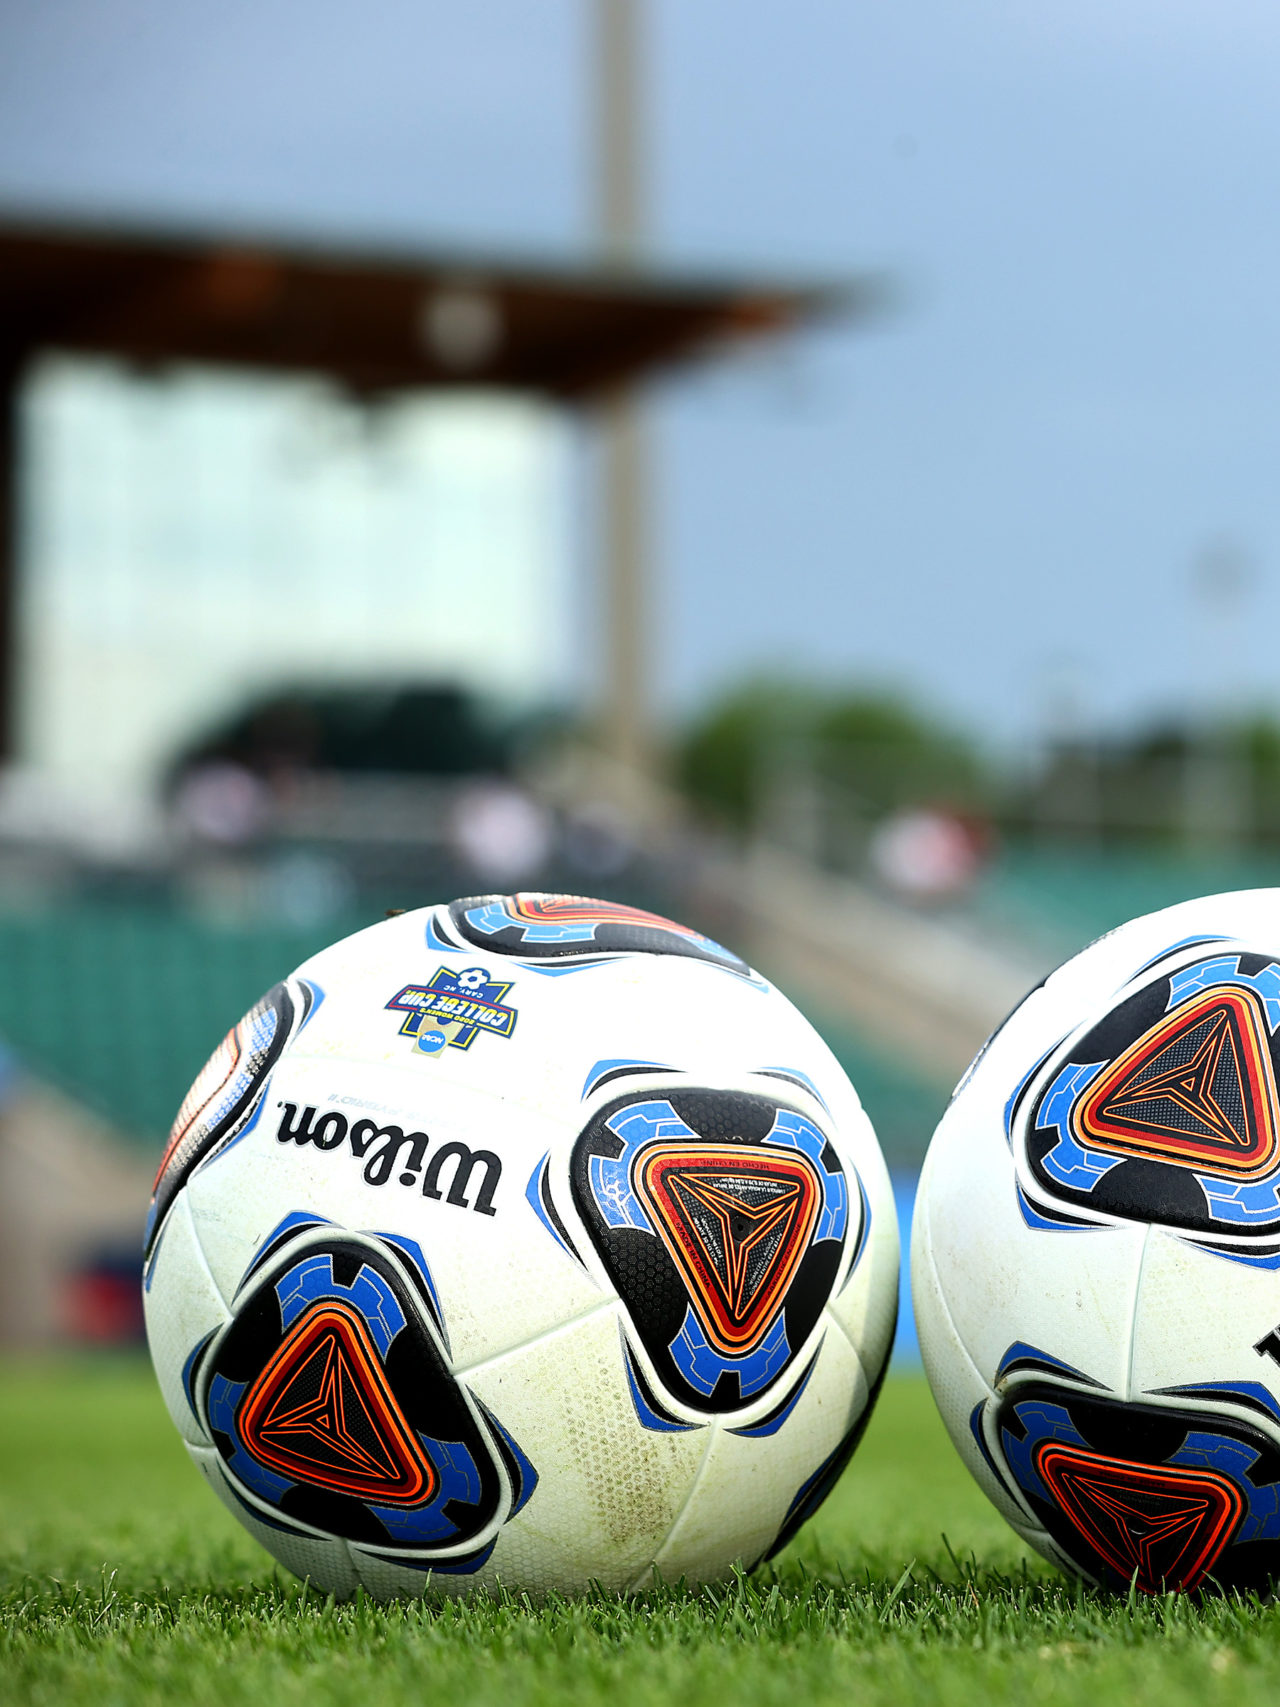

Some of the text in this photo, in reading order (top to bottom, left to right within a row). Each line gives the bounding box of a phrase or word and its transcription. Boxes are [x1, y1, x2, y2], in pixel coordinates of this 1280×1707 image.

[398, 990, 508, 1027] COLLEGE CUP
[419, 1007, 454, 1020] WOMEN'S
[421, 1034, 444, 1045] NCAA
[278, 1102, 502, 1216] Wilson
